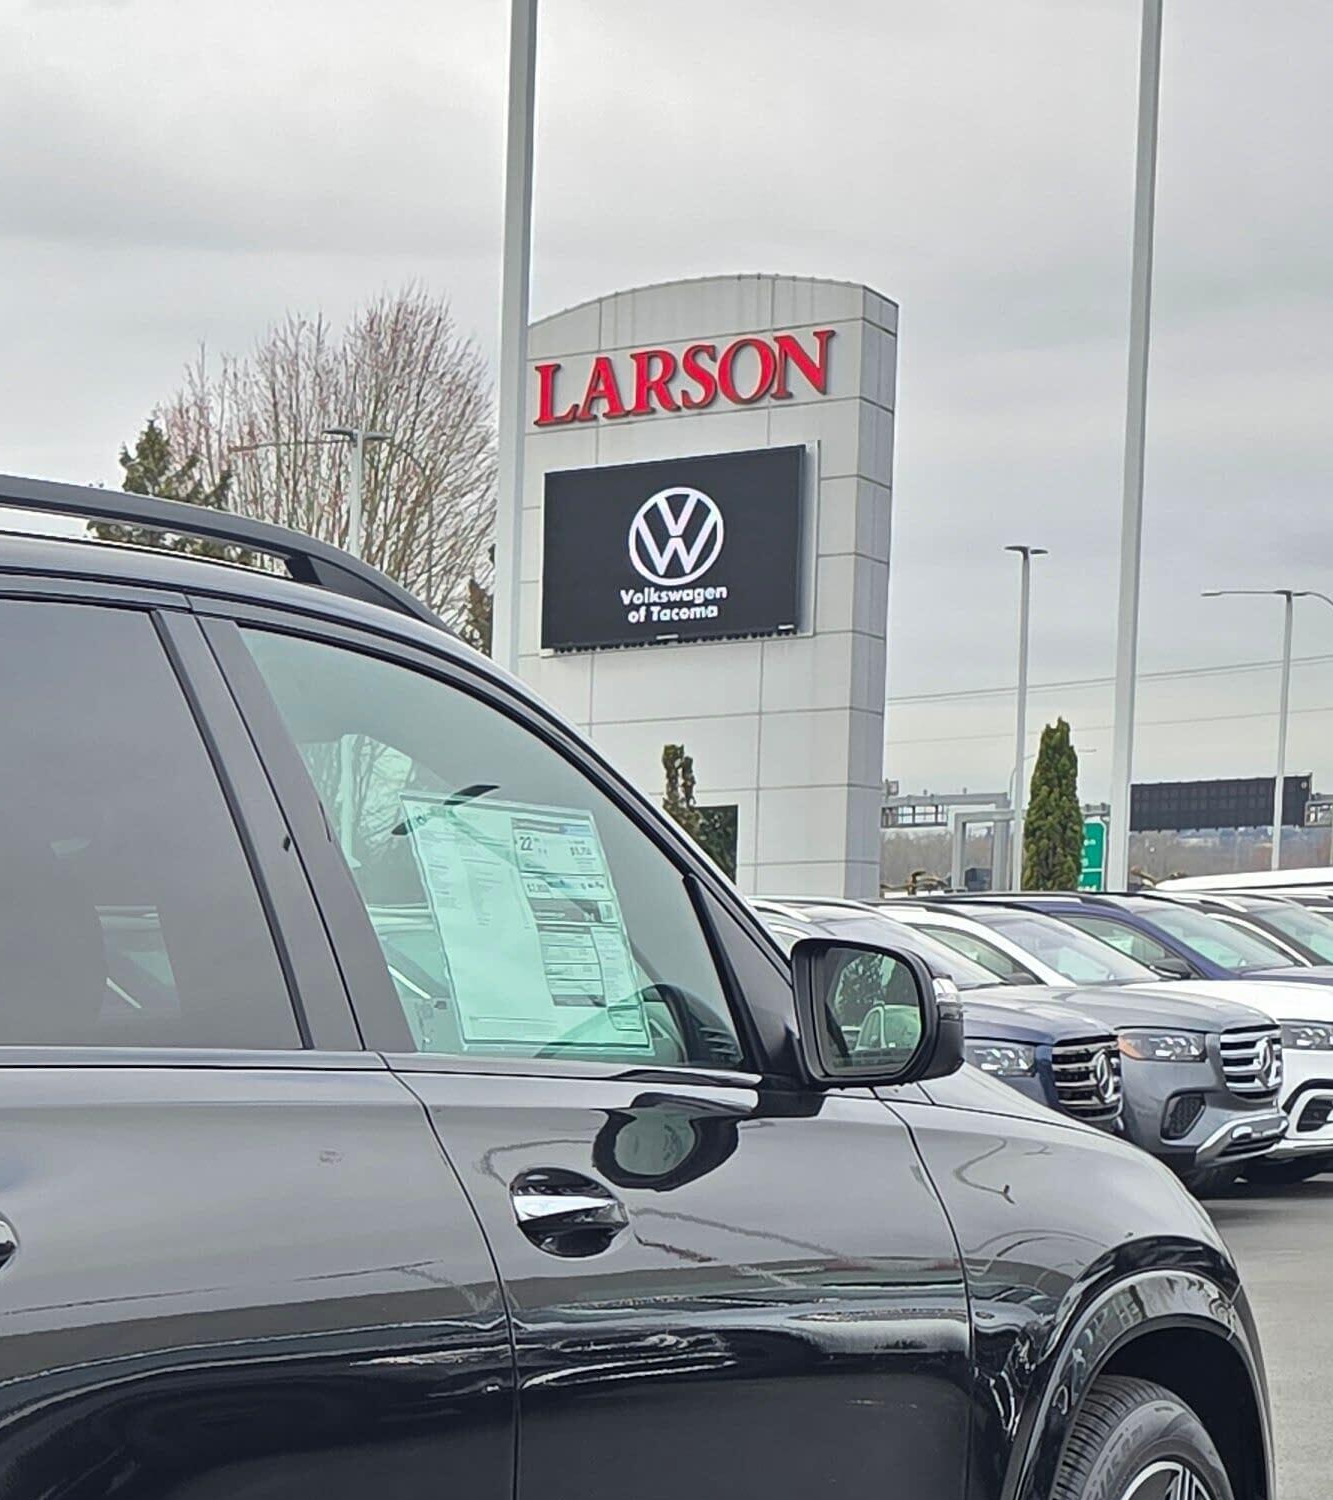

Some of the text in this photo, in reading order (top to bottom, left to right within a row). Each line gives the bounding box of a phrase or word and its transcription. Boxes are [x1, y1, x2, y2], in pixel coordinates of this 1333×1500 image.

[534, 329, 836, 427] LARSON
[620, 586, 728, 605] Volkswagen
[627, 605, 719, 623] of Tacoma
